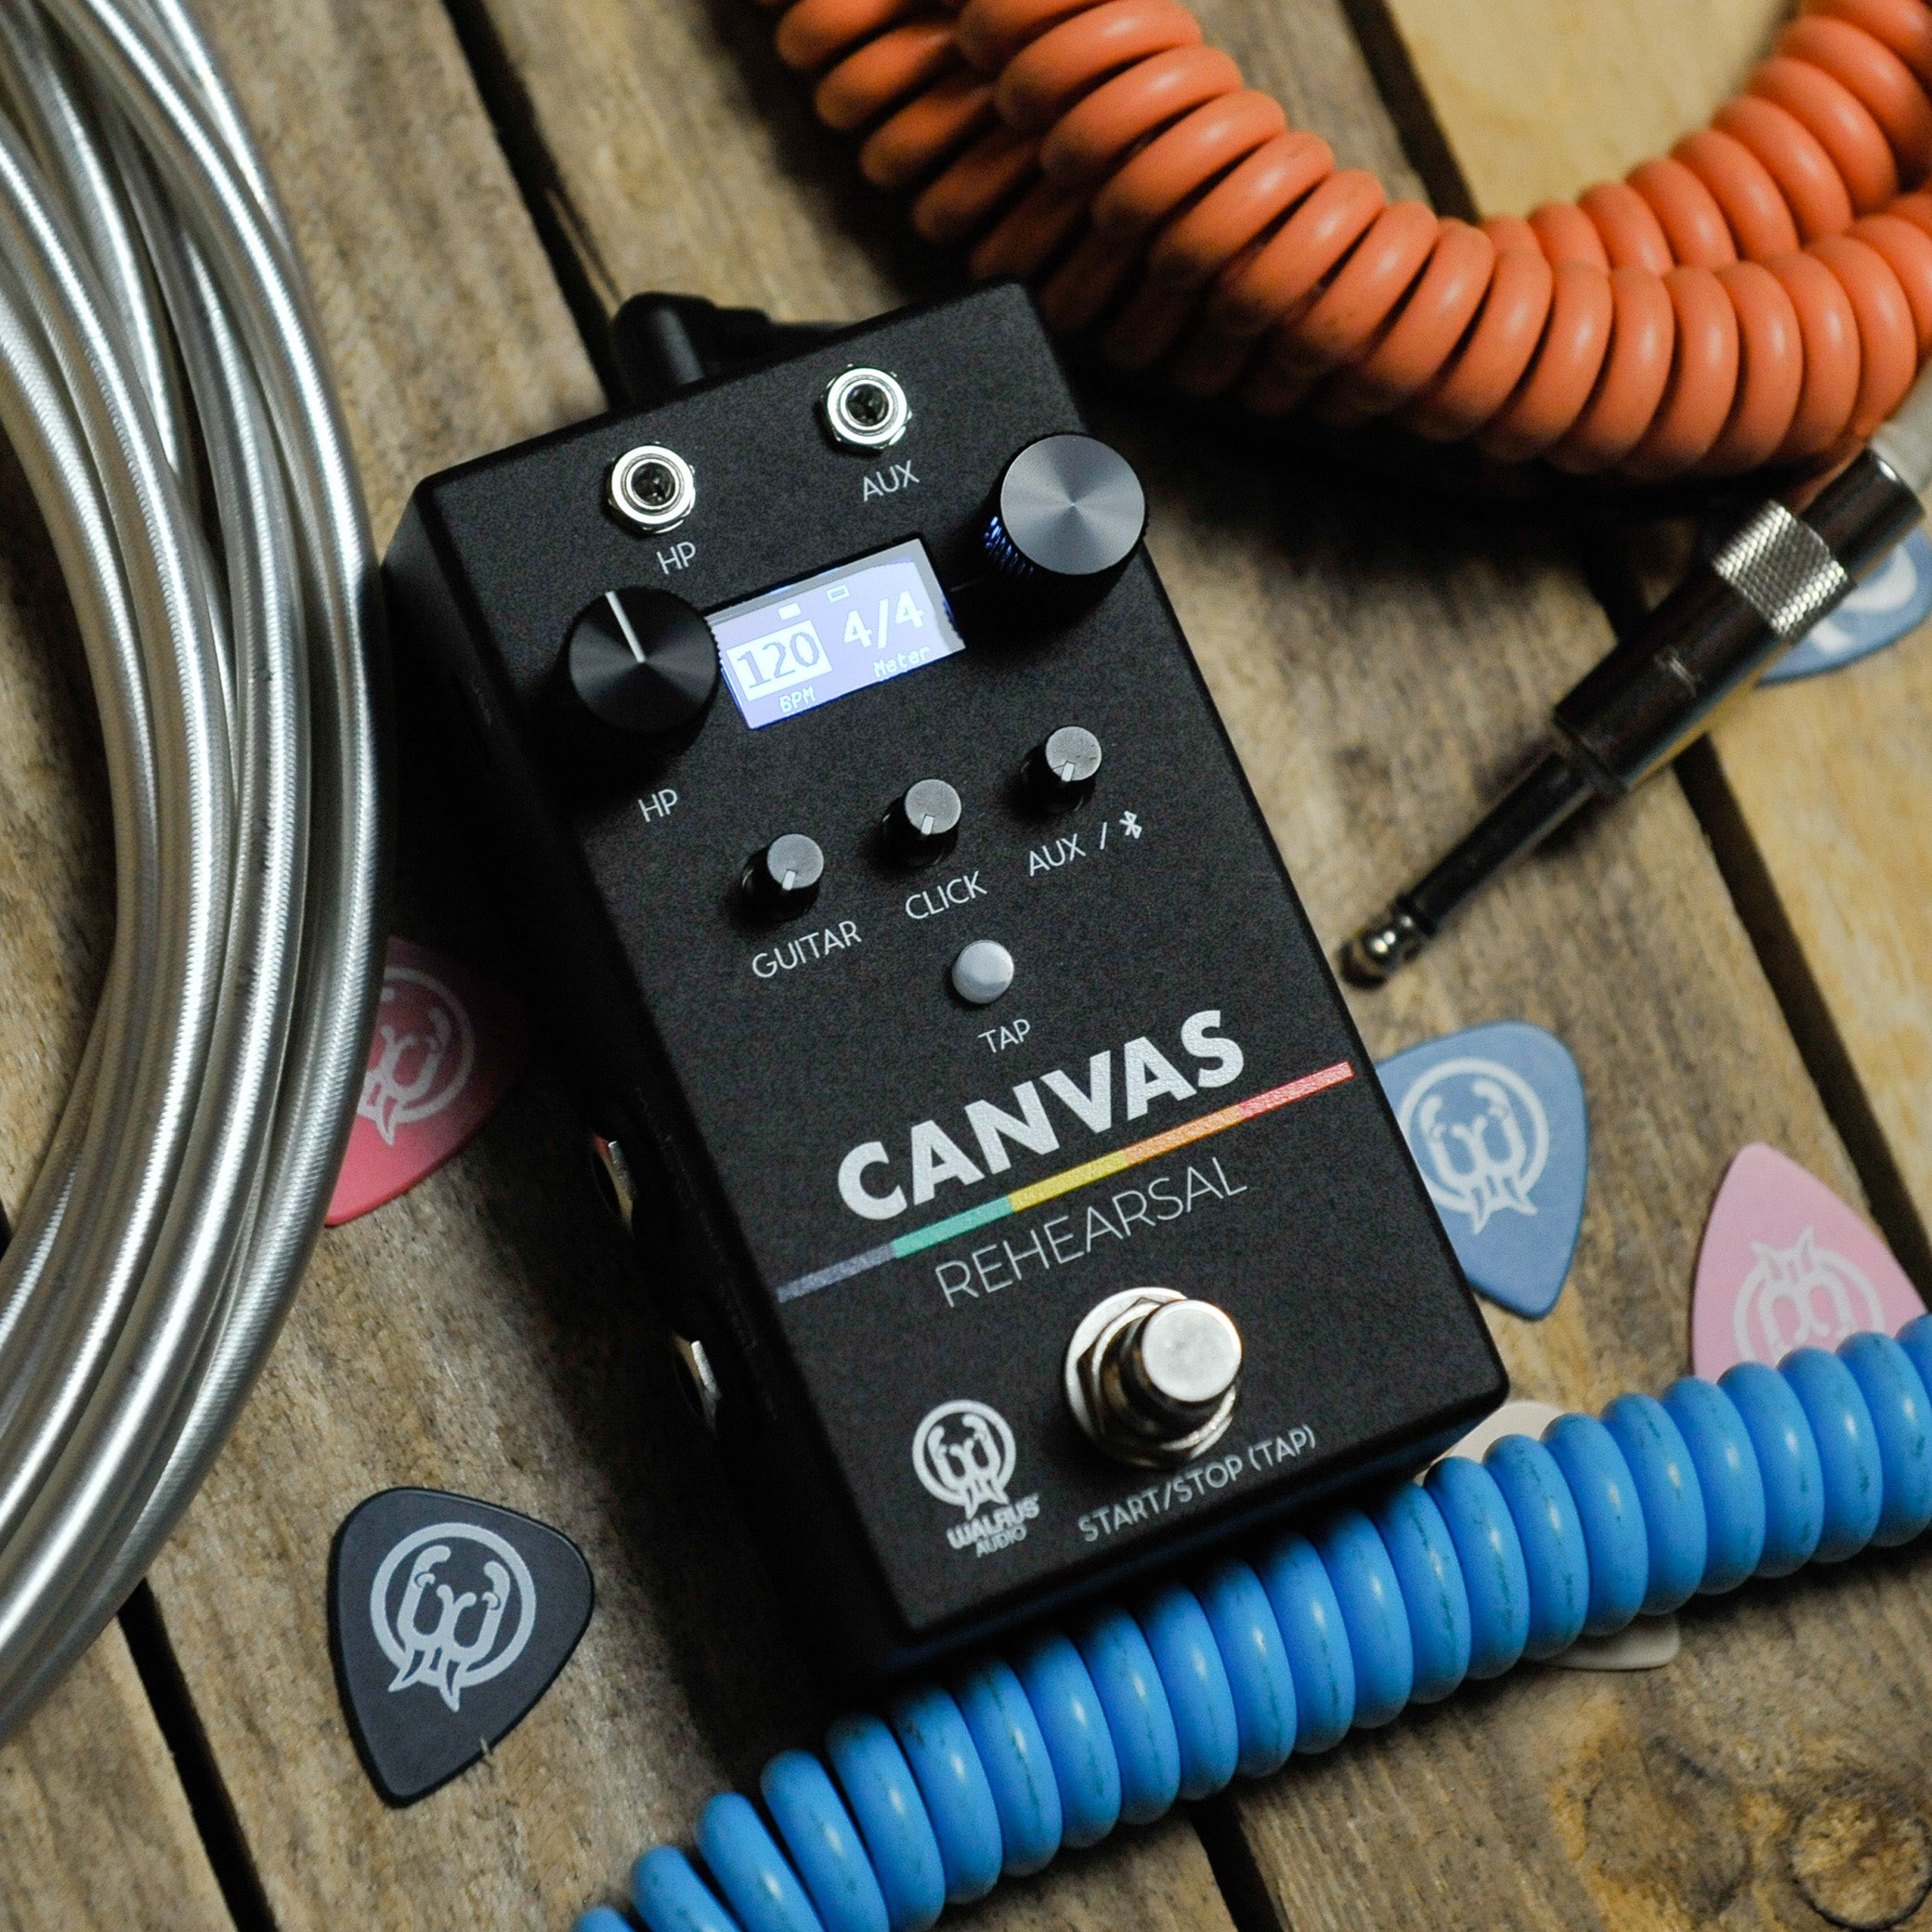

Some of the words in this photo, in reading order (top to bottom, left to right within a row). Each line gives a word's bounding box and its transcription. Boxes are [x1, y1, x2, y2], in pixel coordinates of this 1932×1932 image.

[862, 459, 920, 503] AUX
[656, 541, 697, 575] HP
[842, 590, 924, 649] 4/4
[737, 631, 820, 689] 120
[873, 645, 931, 678] Meter
[778, 685, 816, 713] BPM
[637, 788, 680, 823] HP
[1026, 832, 1088, 877] AUX
[905, 869, 988, 921] CLICK
[751, 920, 863, 979] GUITAR
[978, 1018, 1032, 1054] TAP
[837, 1009, 1245, 1221] CANVAS
[934, 1156, 1247, 1308] REHEARSAL
[1077, 1457, 1245, 1543] START/STOP
[1247, 1423, 1316, 1472] (TAP)
[976, 1523, 1027, 1558] AUDIO
